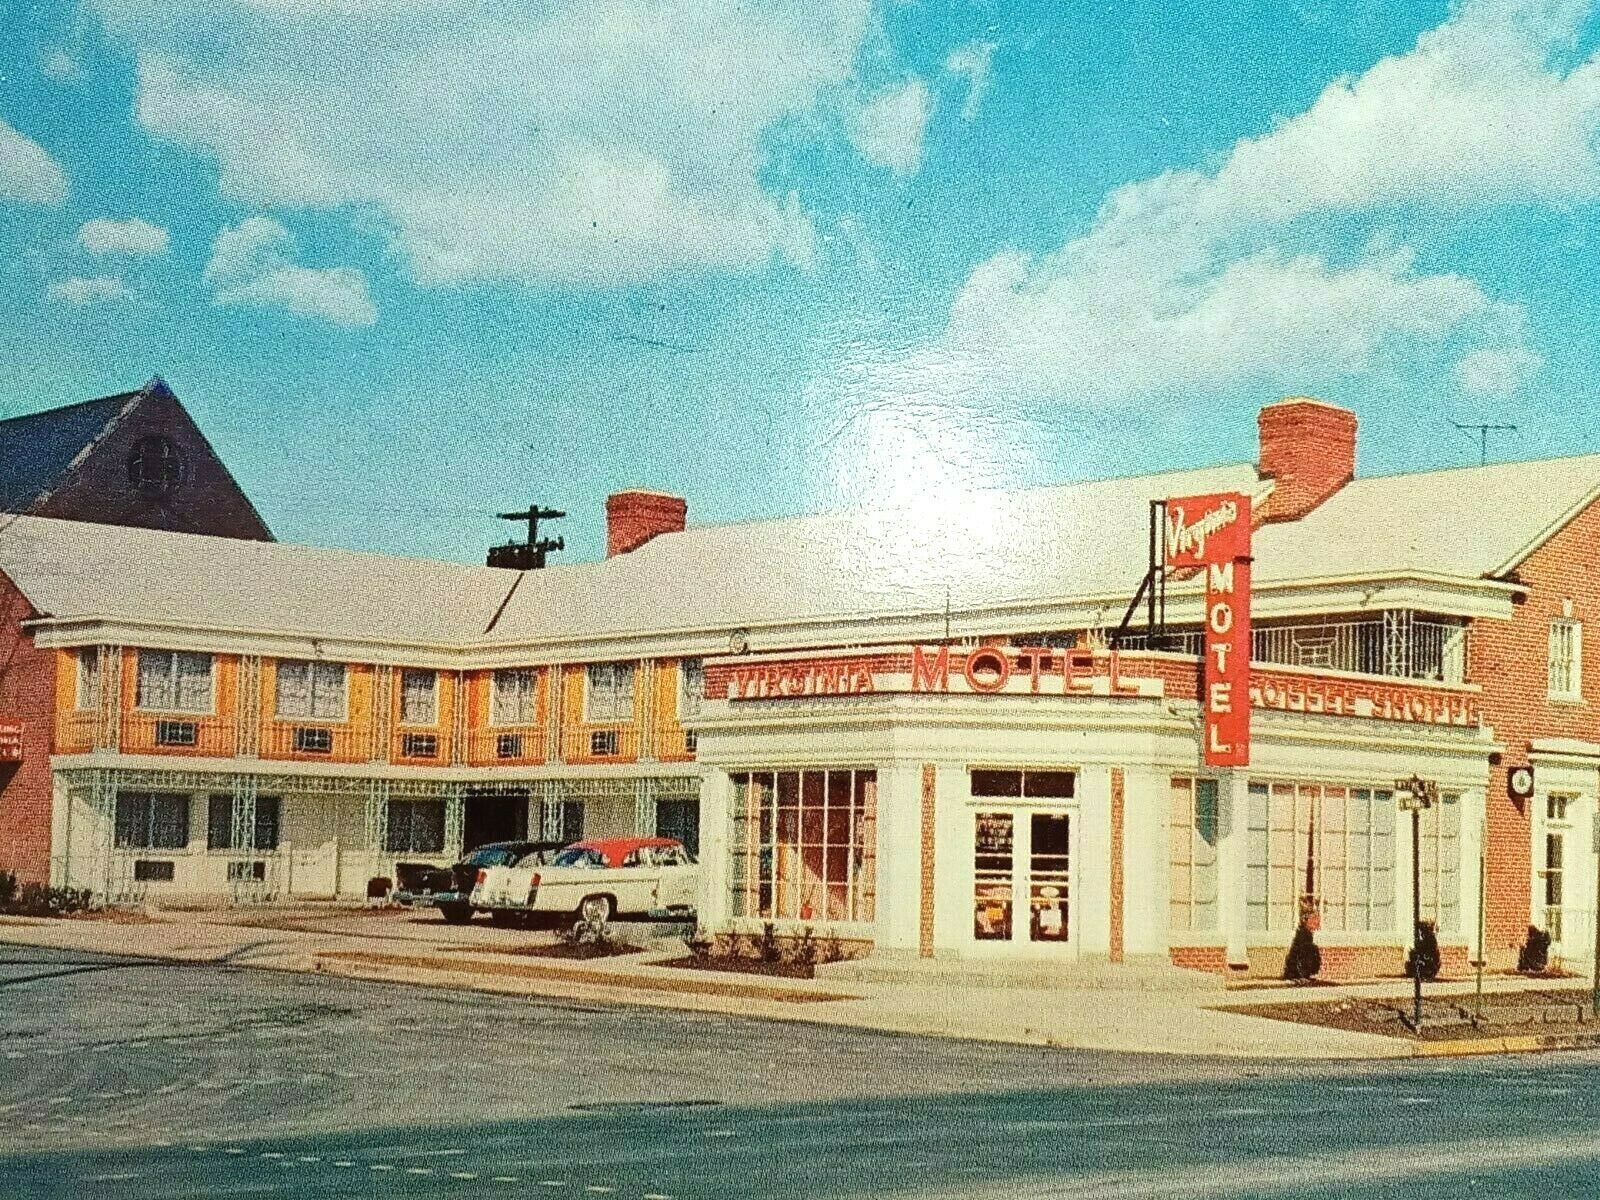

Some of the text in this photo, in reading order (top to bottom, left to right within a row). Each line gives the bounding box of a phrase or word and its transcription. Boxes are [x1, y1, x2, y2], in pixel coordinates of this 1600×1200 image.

[732, 645, 1139, 698] VIRGINIA MOTEL
[1209, 561, 1235, 753] MOTEL
